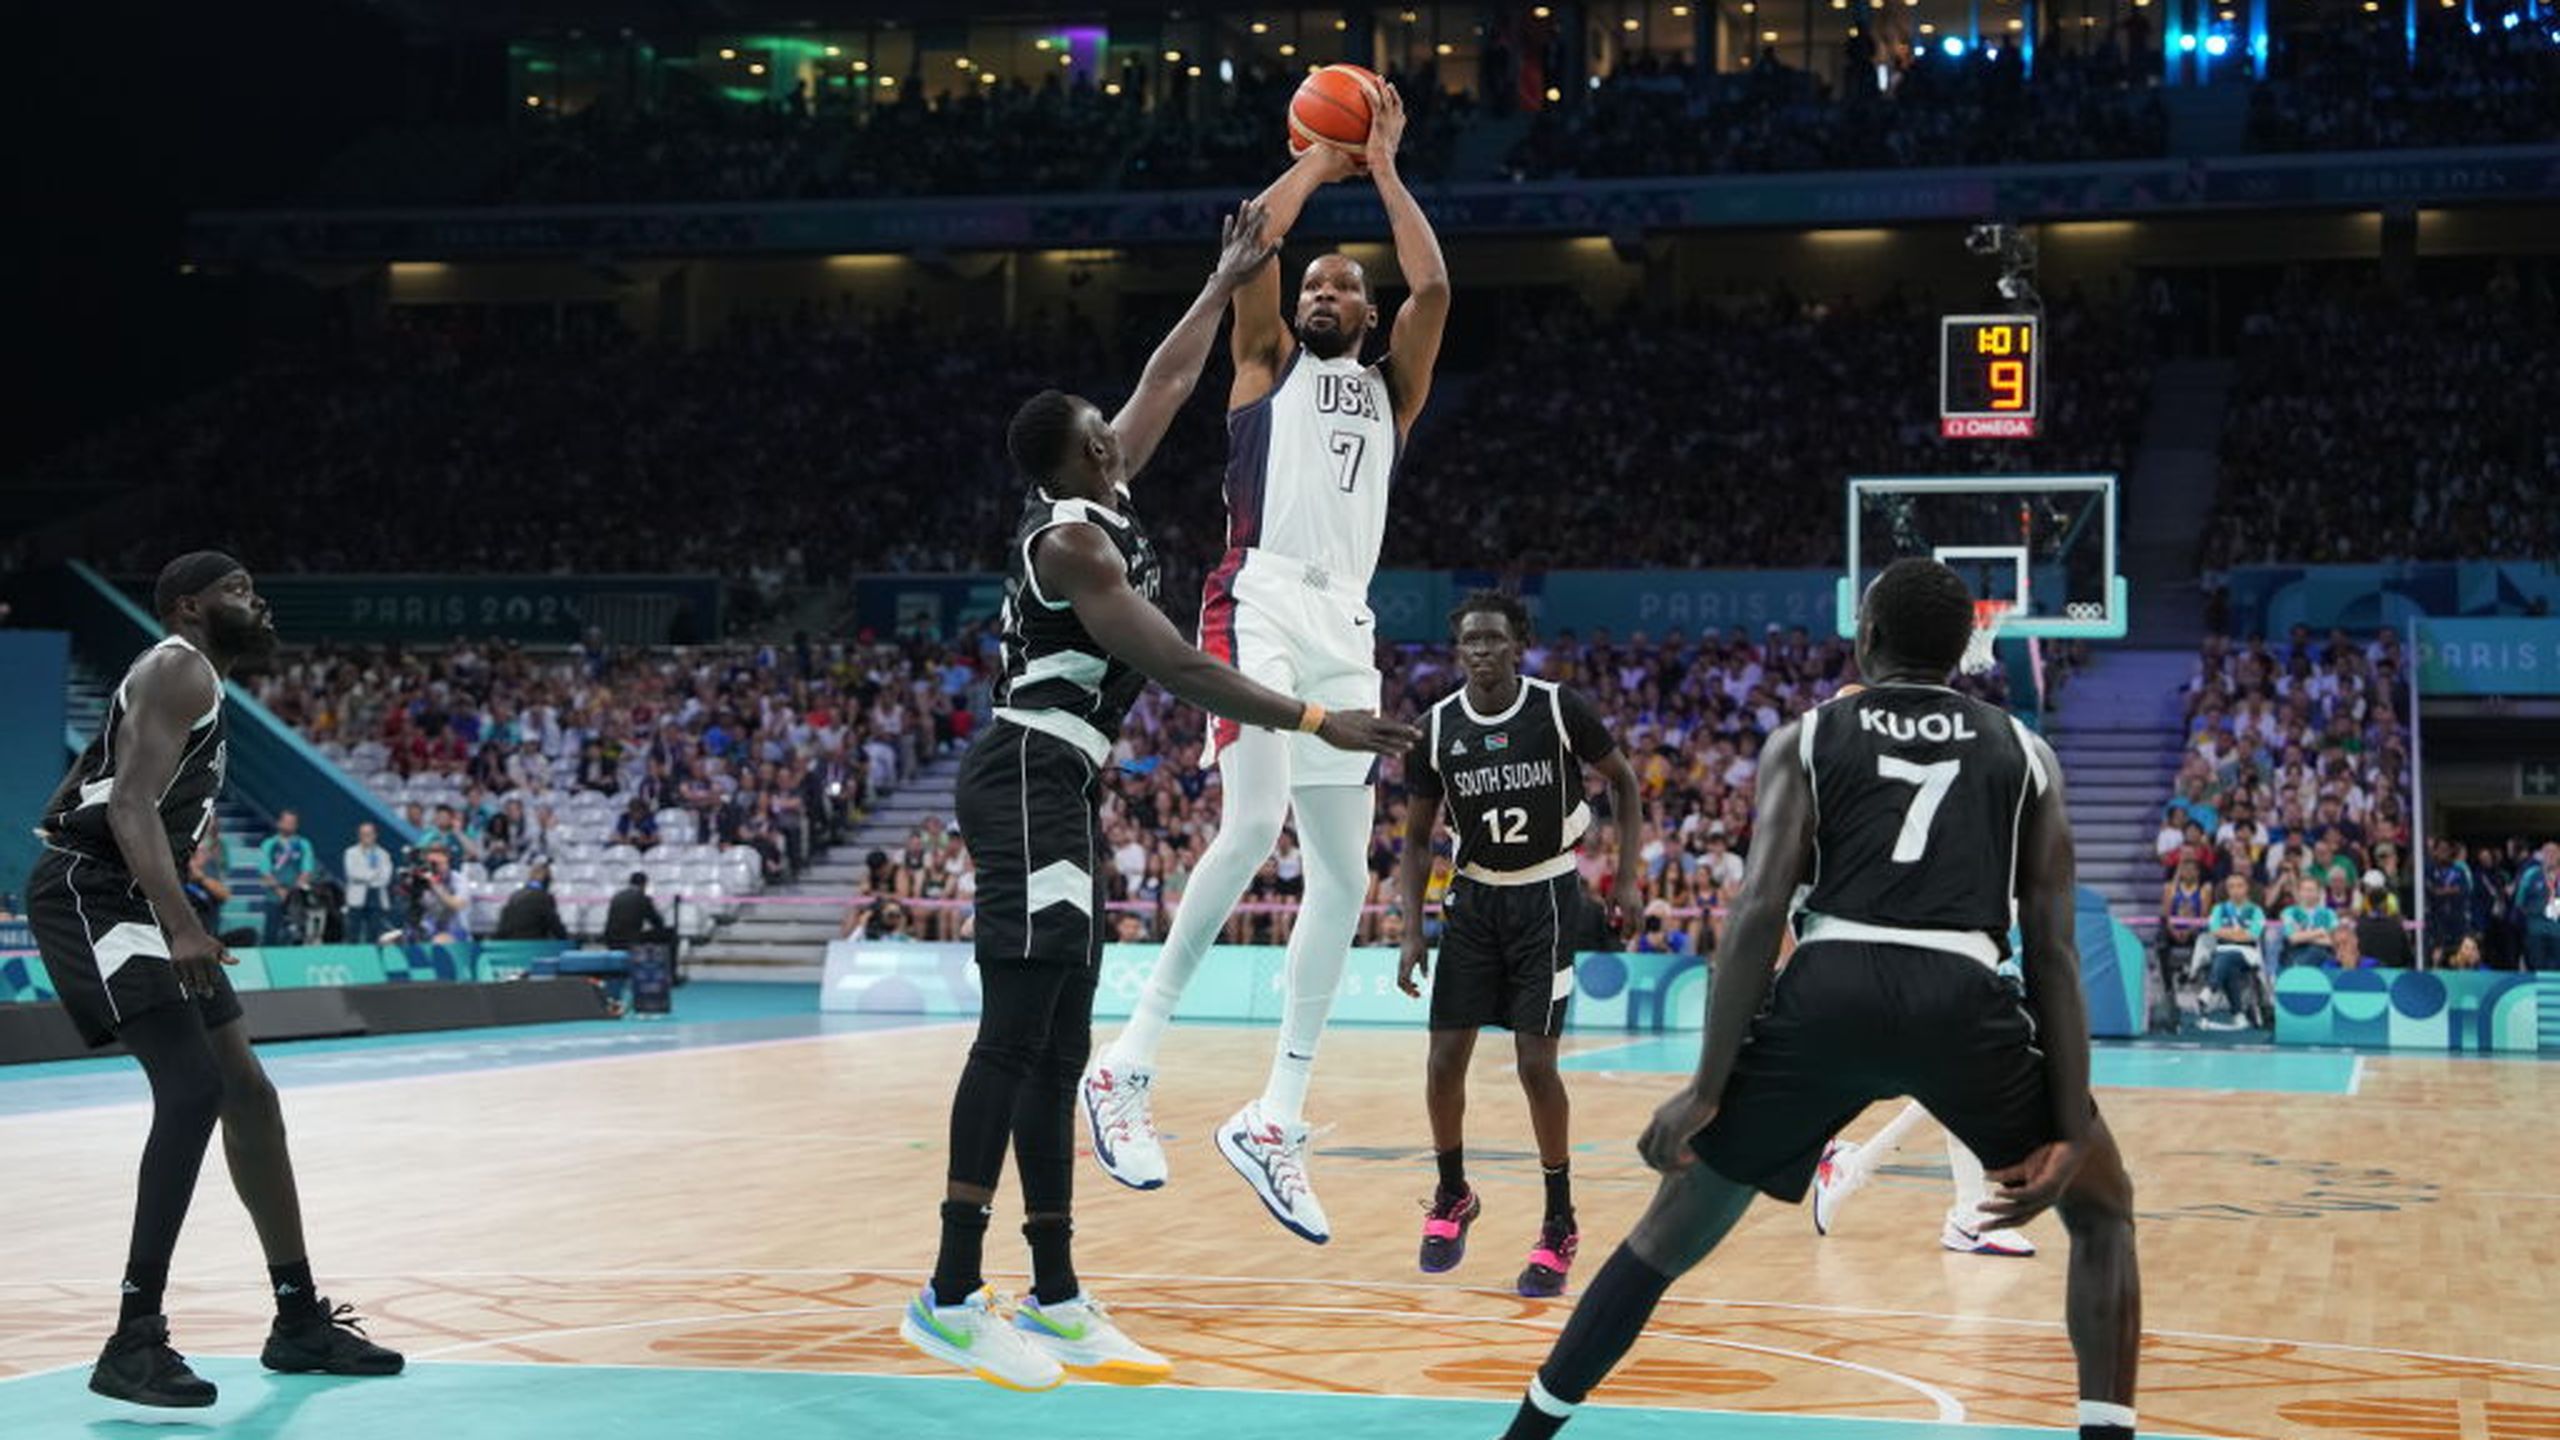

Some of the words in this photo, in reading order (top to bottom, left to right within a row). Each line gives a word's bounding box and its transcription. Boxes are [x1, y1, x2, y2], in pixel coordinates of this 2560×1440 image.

[1979, 326, 2029, 355] 1:01
[1316, 374, 1380, 422] USA
[1990, 361, 2023, 409] 9
[1966, 419, 2029, 436] OMEGA
[1330, 429, 1366, 493] 7
[351, 595, 466, 625] PARIS
[1640, 592, 1768, 621] PARIS
[1859, 707, 1977, 743] KUOL
[1454, 766, 1500, 796] SOUTH
[1502, 759, 1553, 791] SUDAN
[1481, 807, 1529, 843] 12
[1877, 754, 1961, 863] 7
